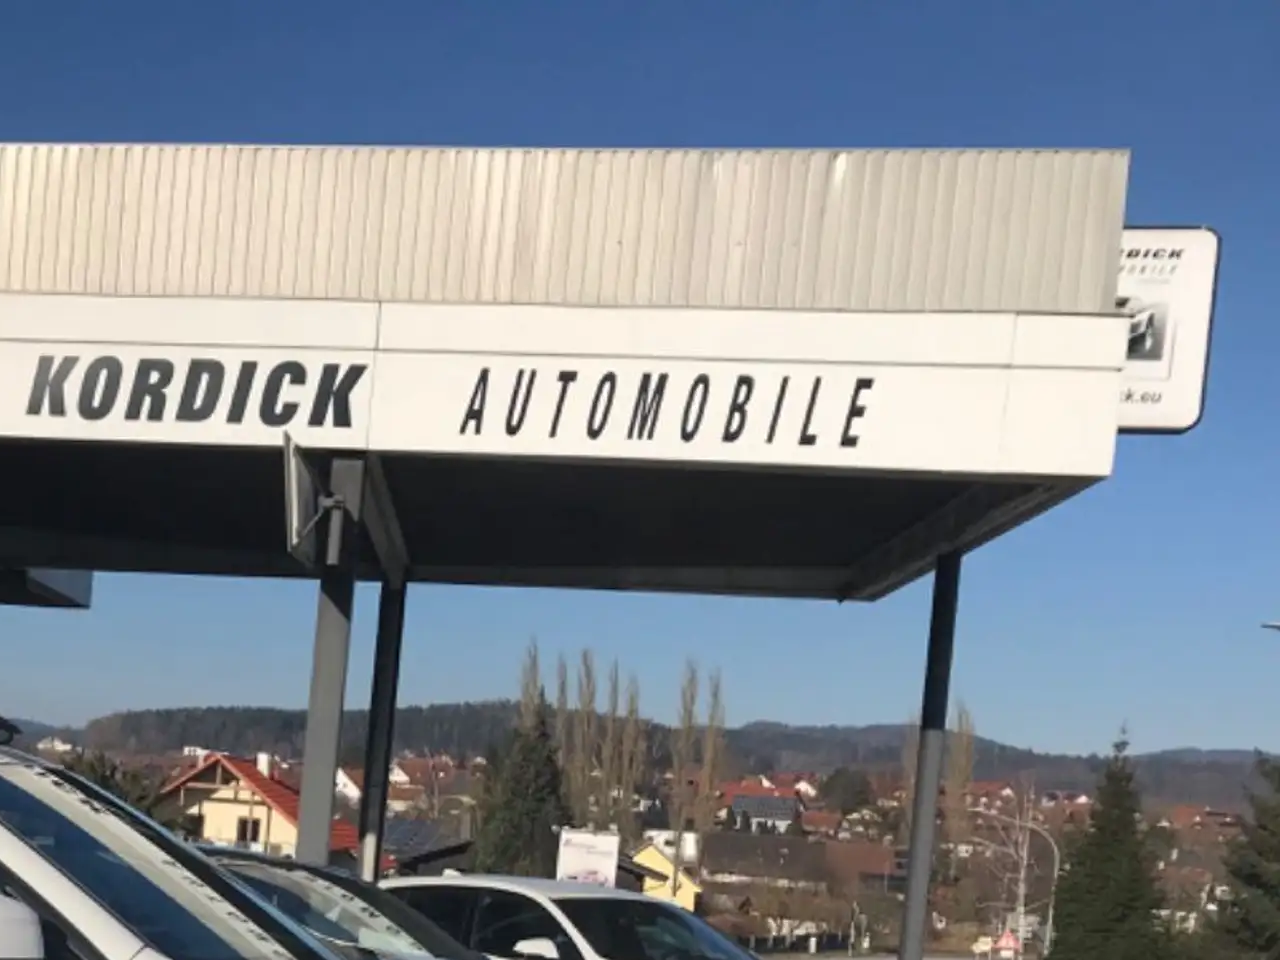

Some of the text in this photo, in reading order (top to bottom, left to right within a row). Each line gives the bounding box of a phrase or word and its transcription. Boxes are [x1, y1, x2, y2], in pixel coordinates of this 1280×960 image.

[1120, 247, 1184, 260] DICK
[26, 354, 874, 447] KORDICK AUTOMOBILE
